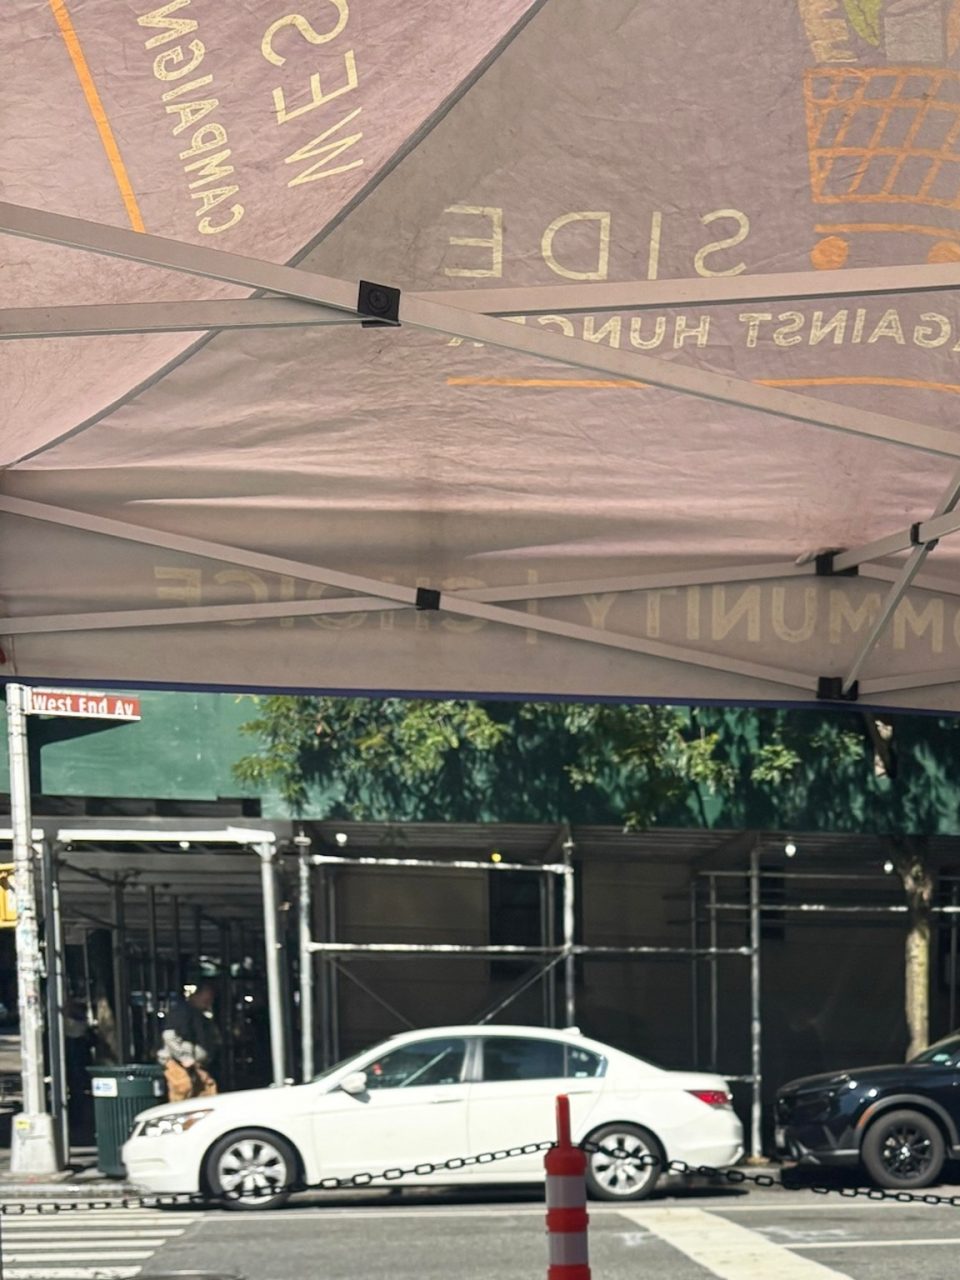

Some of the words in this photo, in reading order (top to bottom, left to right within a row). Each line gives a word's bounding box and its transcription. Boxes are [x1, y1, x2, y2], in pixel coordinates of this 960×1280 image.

[31, 694, 73, 713] West
[78, 697, 109, 715] End
[114, 699, 135, 716] Av
